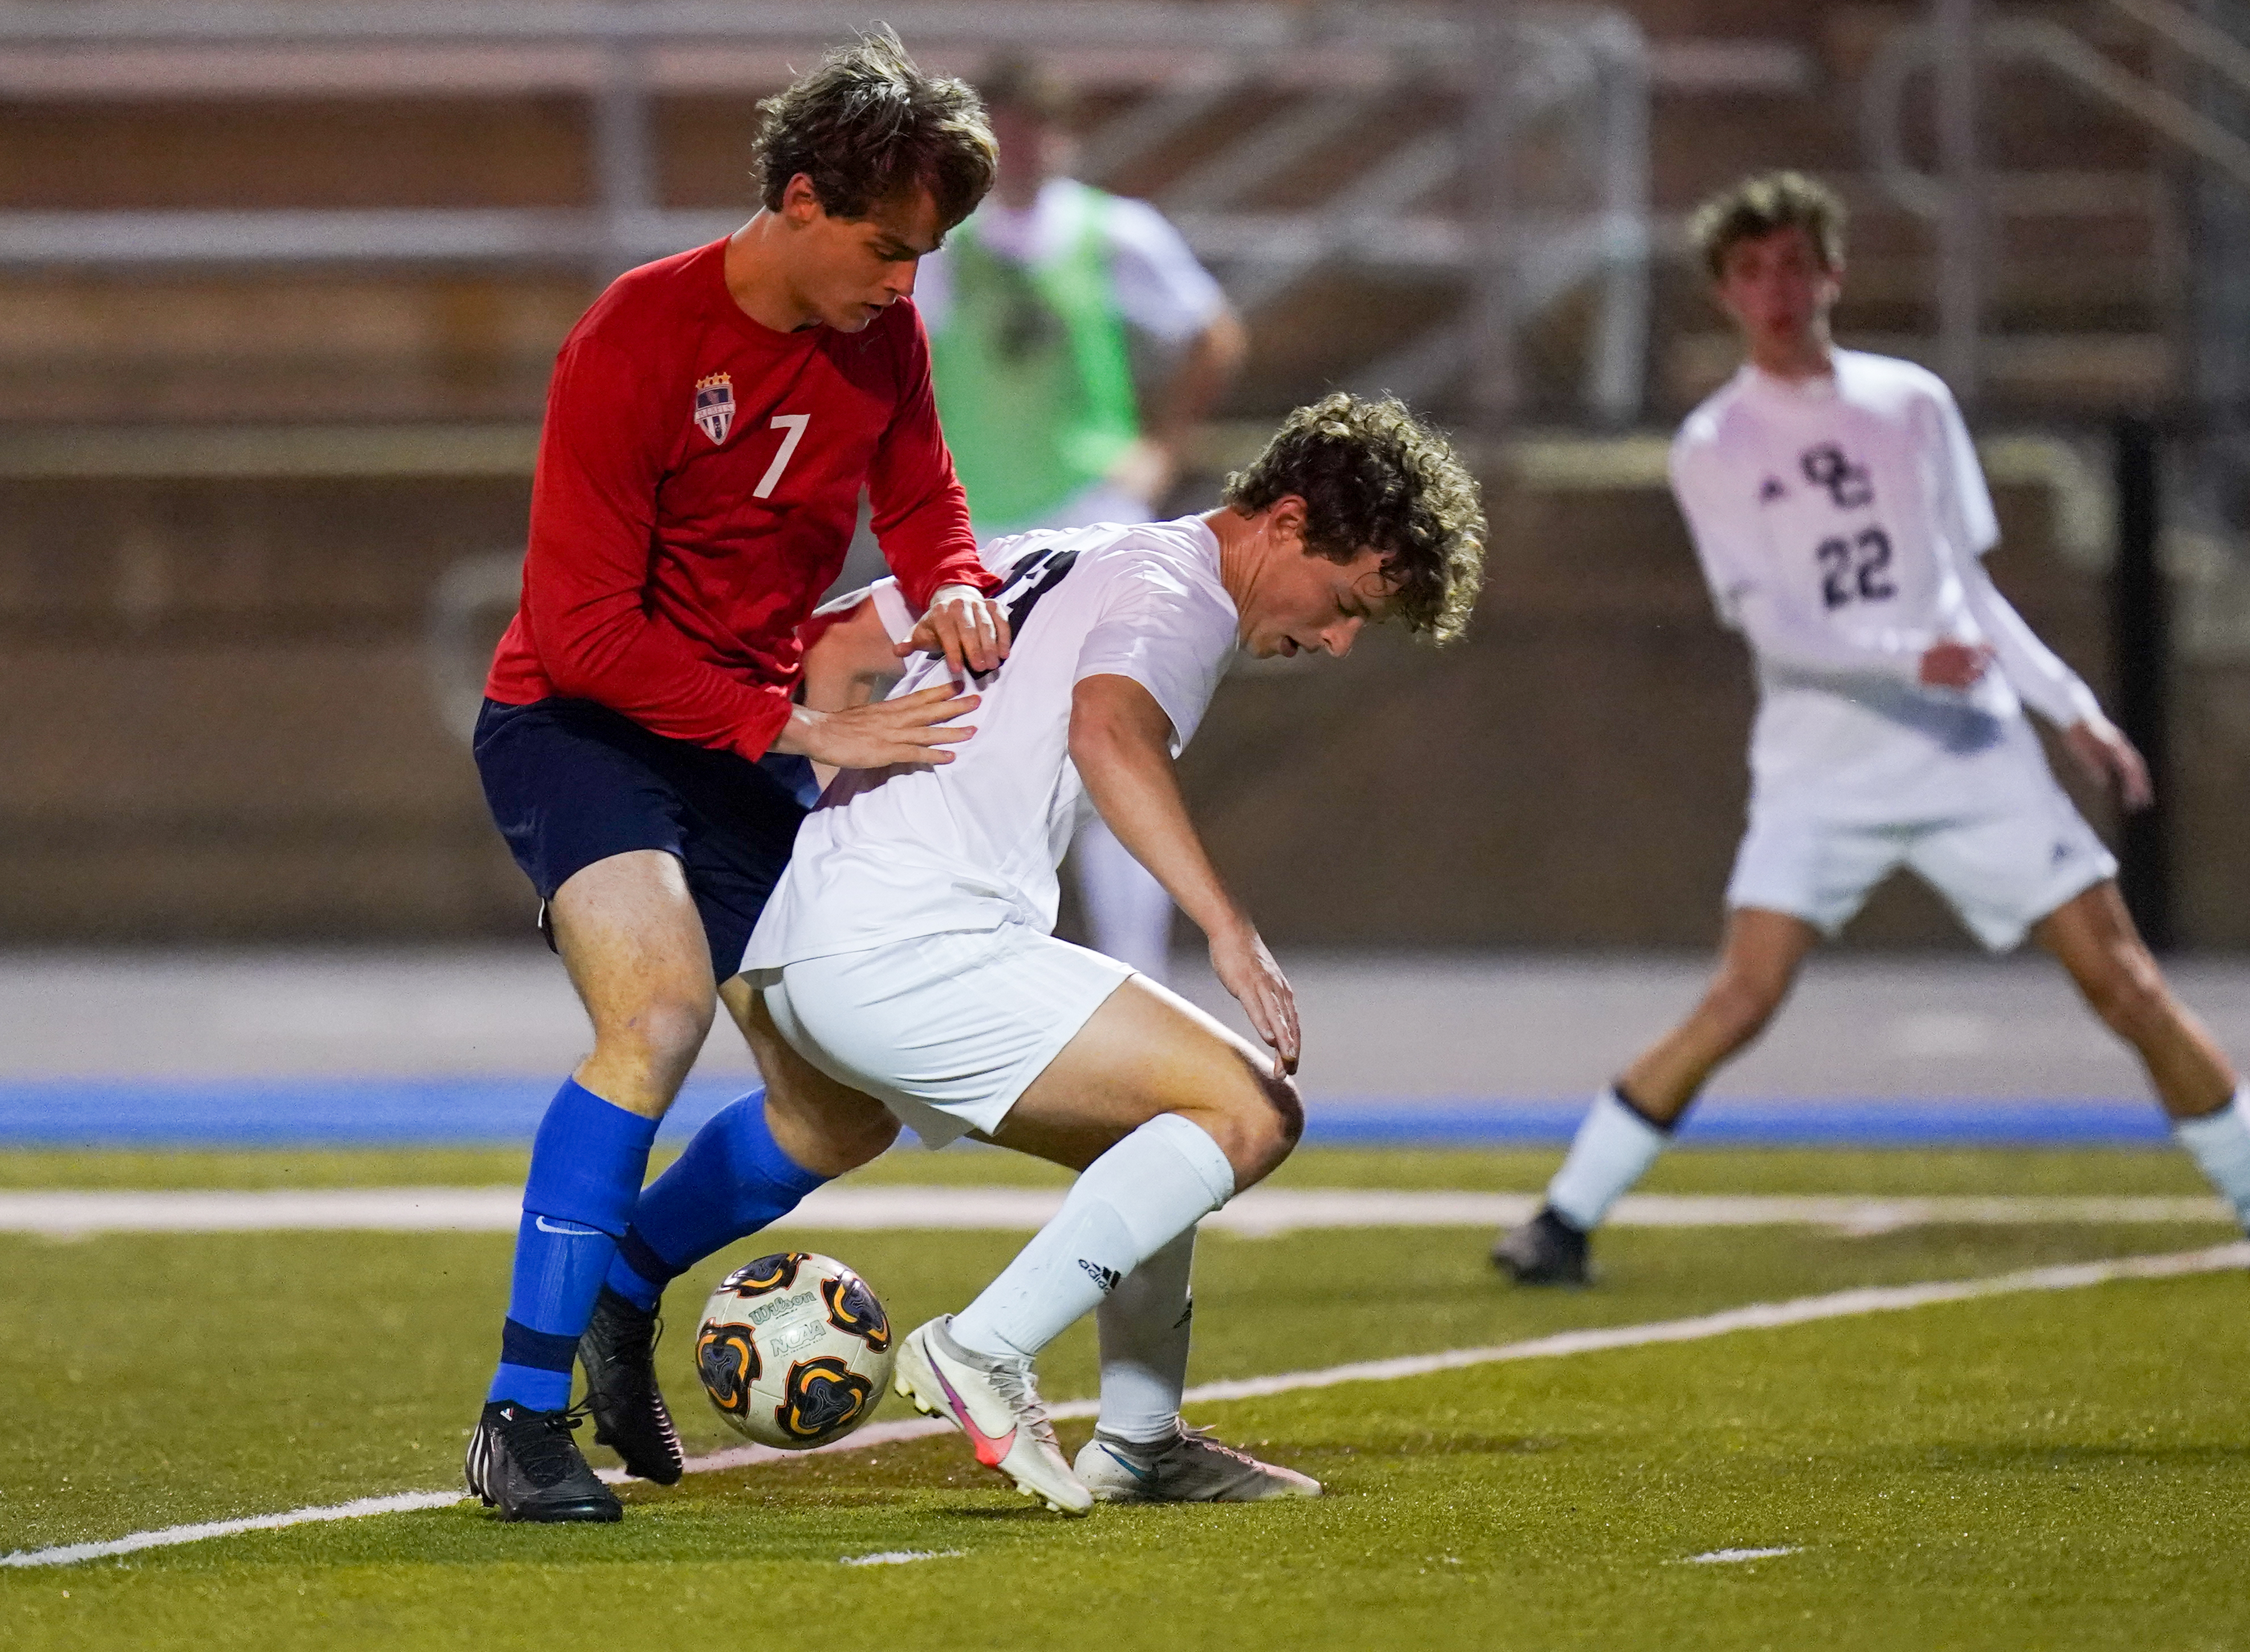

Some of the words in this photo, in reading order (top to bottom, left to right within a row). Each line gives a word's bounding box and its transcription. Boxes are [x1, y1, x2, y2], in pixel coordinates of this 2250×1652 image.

[752, 413, 811, 499] 7
[1816, 525, 1897, 610] 22
[1078, 1259, 1111, 1296] adida
[748, 1291, 817, 1325] Wilson
[770, 1319, 827, 1357] NCAA
